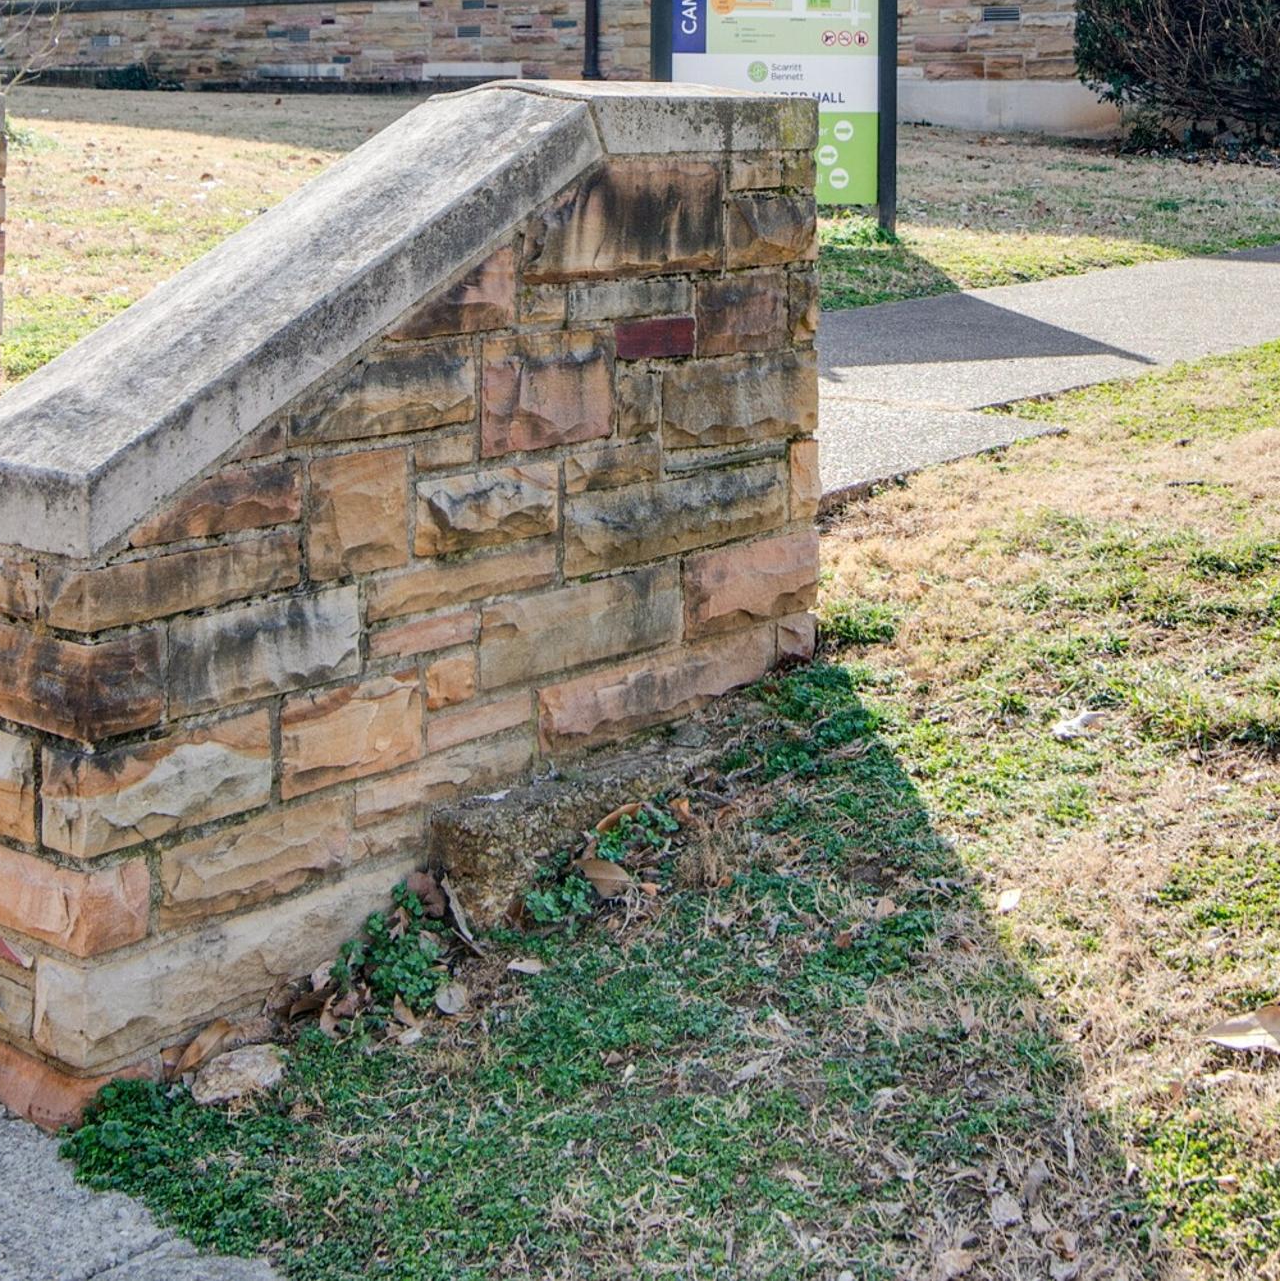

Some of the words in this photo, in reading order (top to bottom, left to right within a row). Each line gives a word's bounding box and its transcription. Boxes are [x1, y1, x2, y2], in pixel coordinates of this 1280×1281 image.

[771, 63, 802, 71] Scarritt
[771, 72, 803, 80] Bennett
[812, 92, 845, 103] HALL
